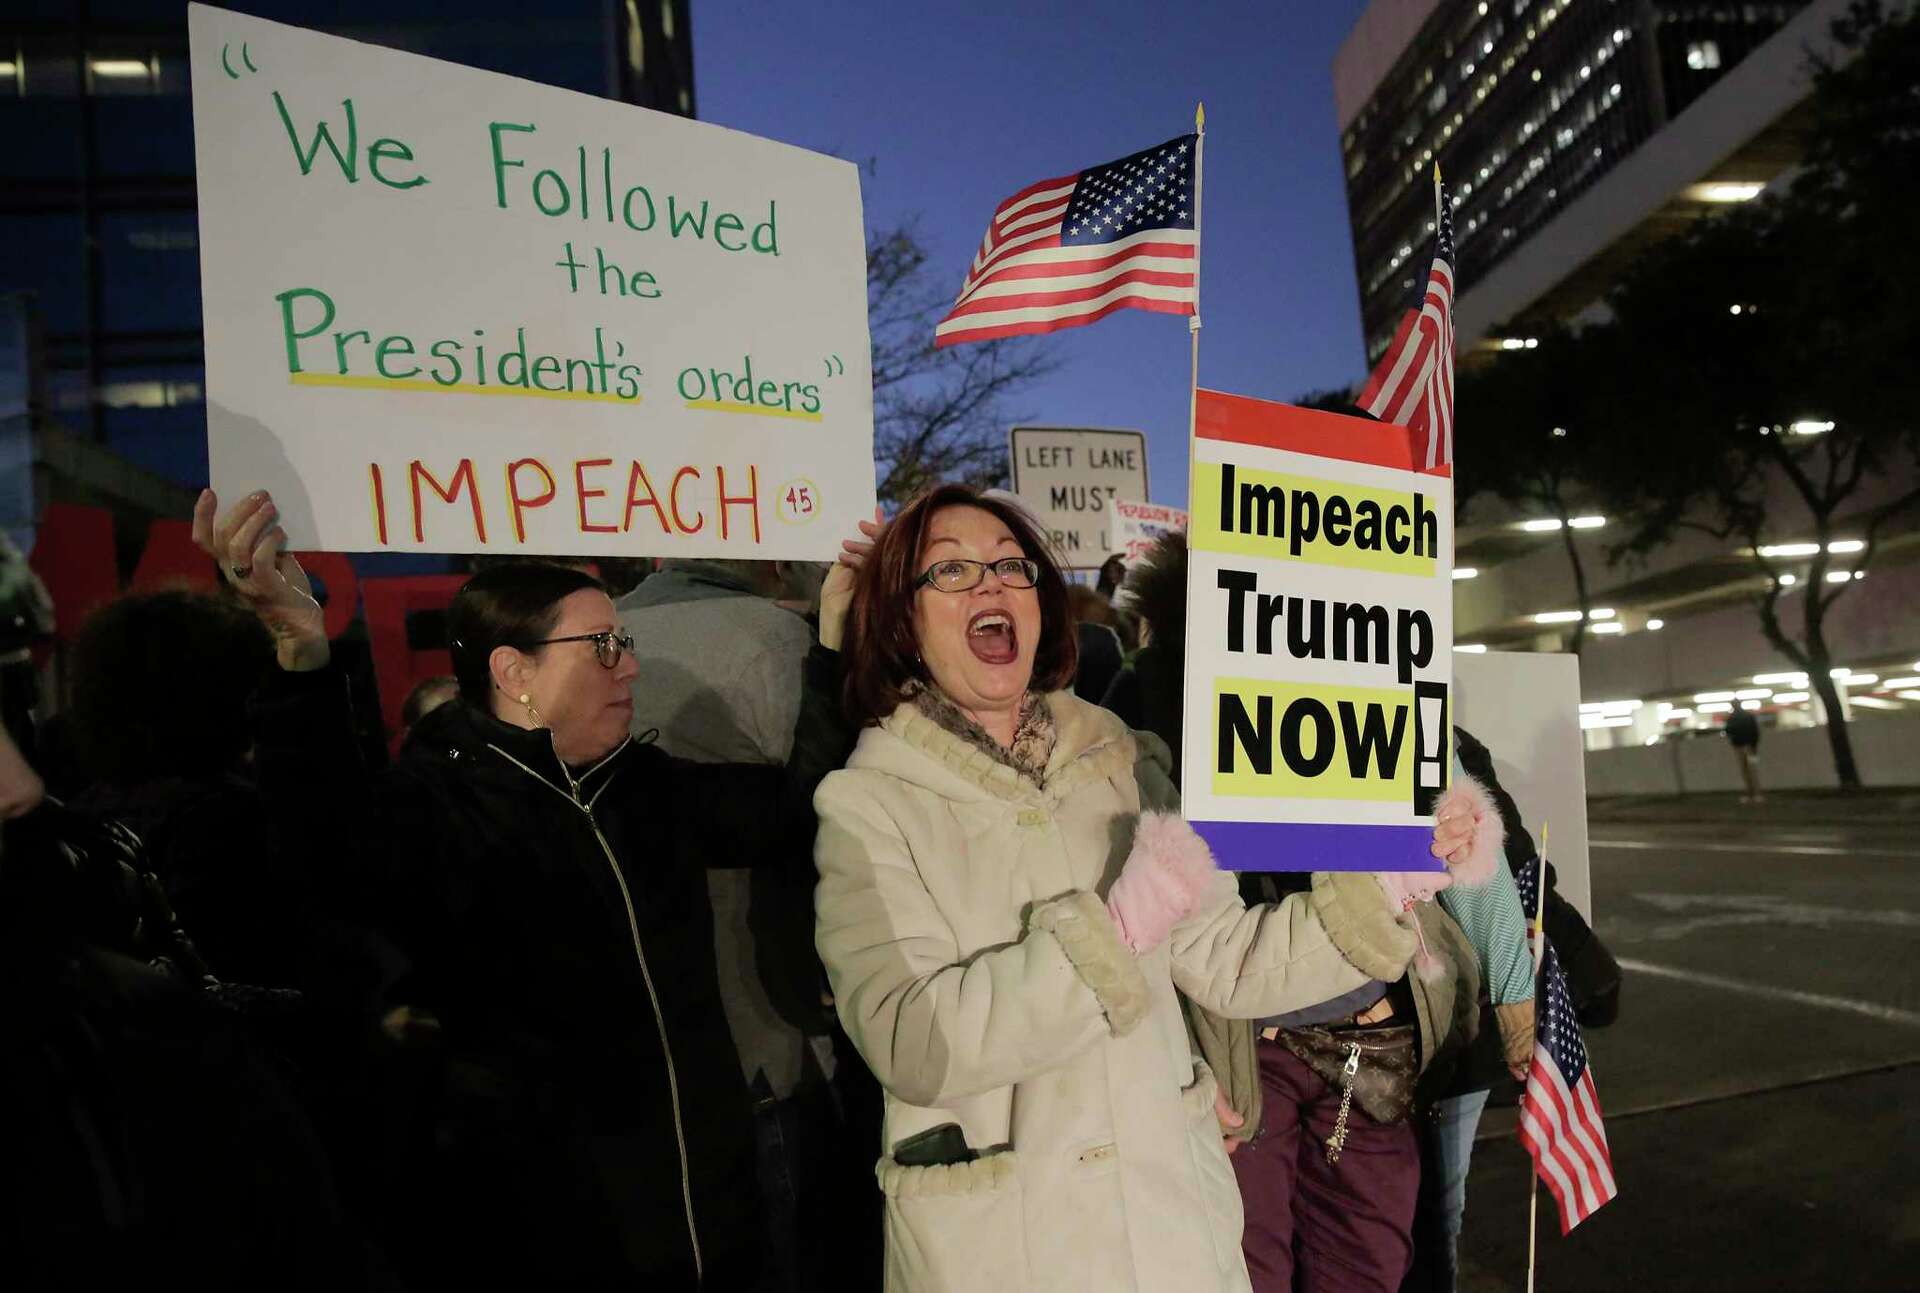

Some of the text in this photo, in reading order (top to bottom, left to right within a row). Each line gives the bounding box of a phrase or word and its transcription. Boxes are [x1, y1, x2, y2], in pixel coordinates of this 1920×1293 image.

[488, 121, 780, 256] Followed
[556, 242, 662, 298] the
[276, 287, 641, 399] President's
[370, 458, 812, 545] IMPEACH 45
[1026, 447, 1137, 471] LEFT LANE
[1220, 463, 1438, 559] Impeach
[1217, 569, 1434, 685] Trump
[1217, 690, 1446, 794] NOW!
